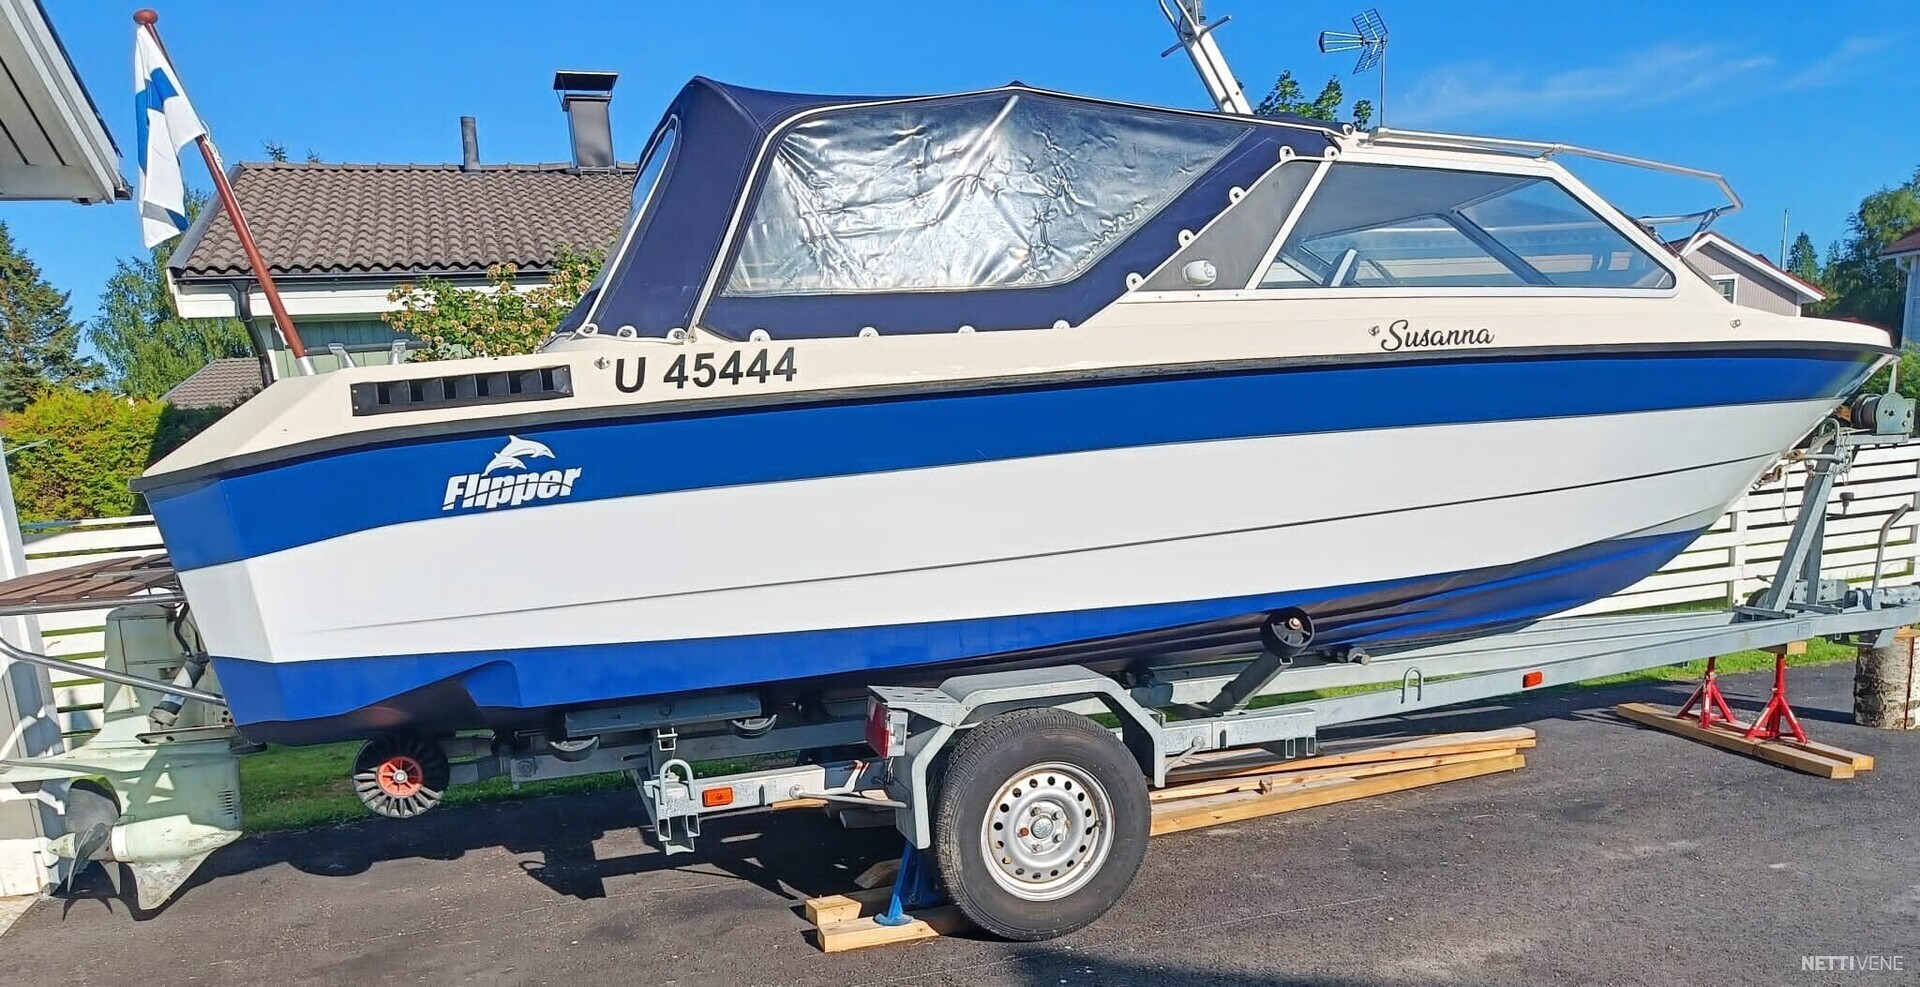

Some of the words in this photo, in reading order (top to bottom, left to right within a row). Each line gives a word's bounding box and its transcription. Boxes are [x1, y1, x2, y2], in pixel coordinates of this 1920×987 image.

[1380, 319, 1495, 351] Susanna
[615, 357, 645, 393] U
[663, 346, 797, 389] 45444
[442, 466, 582, 511] Flipper
